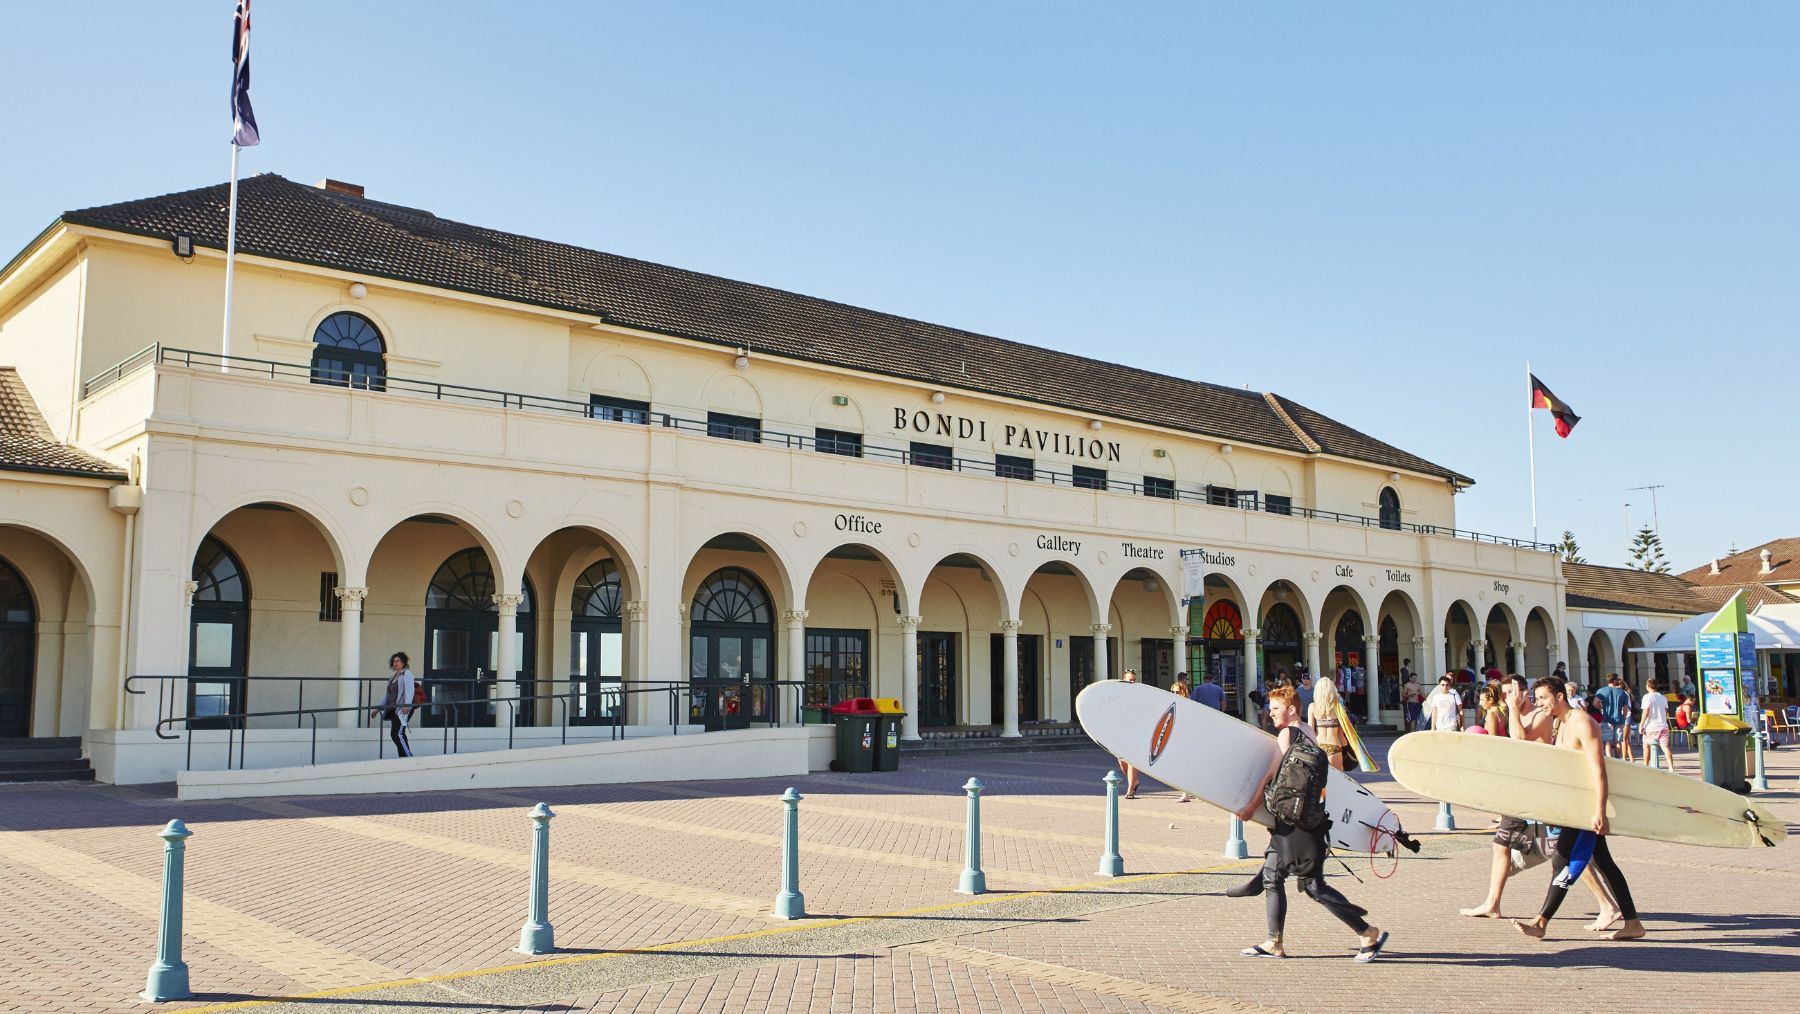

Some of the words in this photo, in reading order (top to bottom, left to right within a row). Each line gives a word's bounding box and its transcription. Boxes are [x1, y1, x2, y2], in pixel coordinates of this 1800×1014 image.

[893, 407, 986, 442] BONDI
[1005, 424, 1121, 463] PAVILION
[834, 514, 882, 535] Office
[1036, 534, 1082, 557] Gallery
[1121, 542, 1164, 560] Theatre
[1200, 550, 1236, 567] Studios
[1335, 564, 1354, 578] Cafe
[1385, 569, 1411, 583] Toilets
[1493, 579, 1510, 595] Shop
